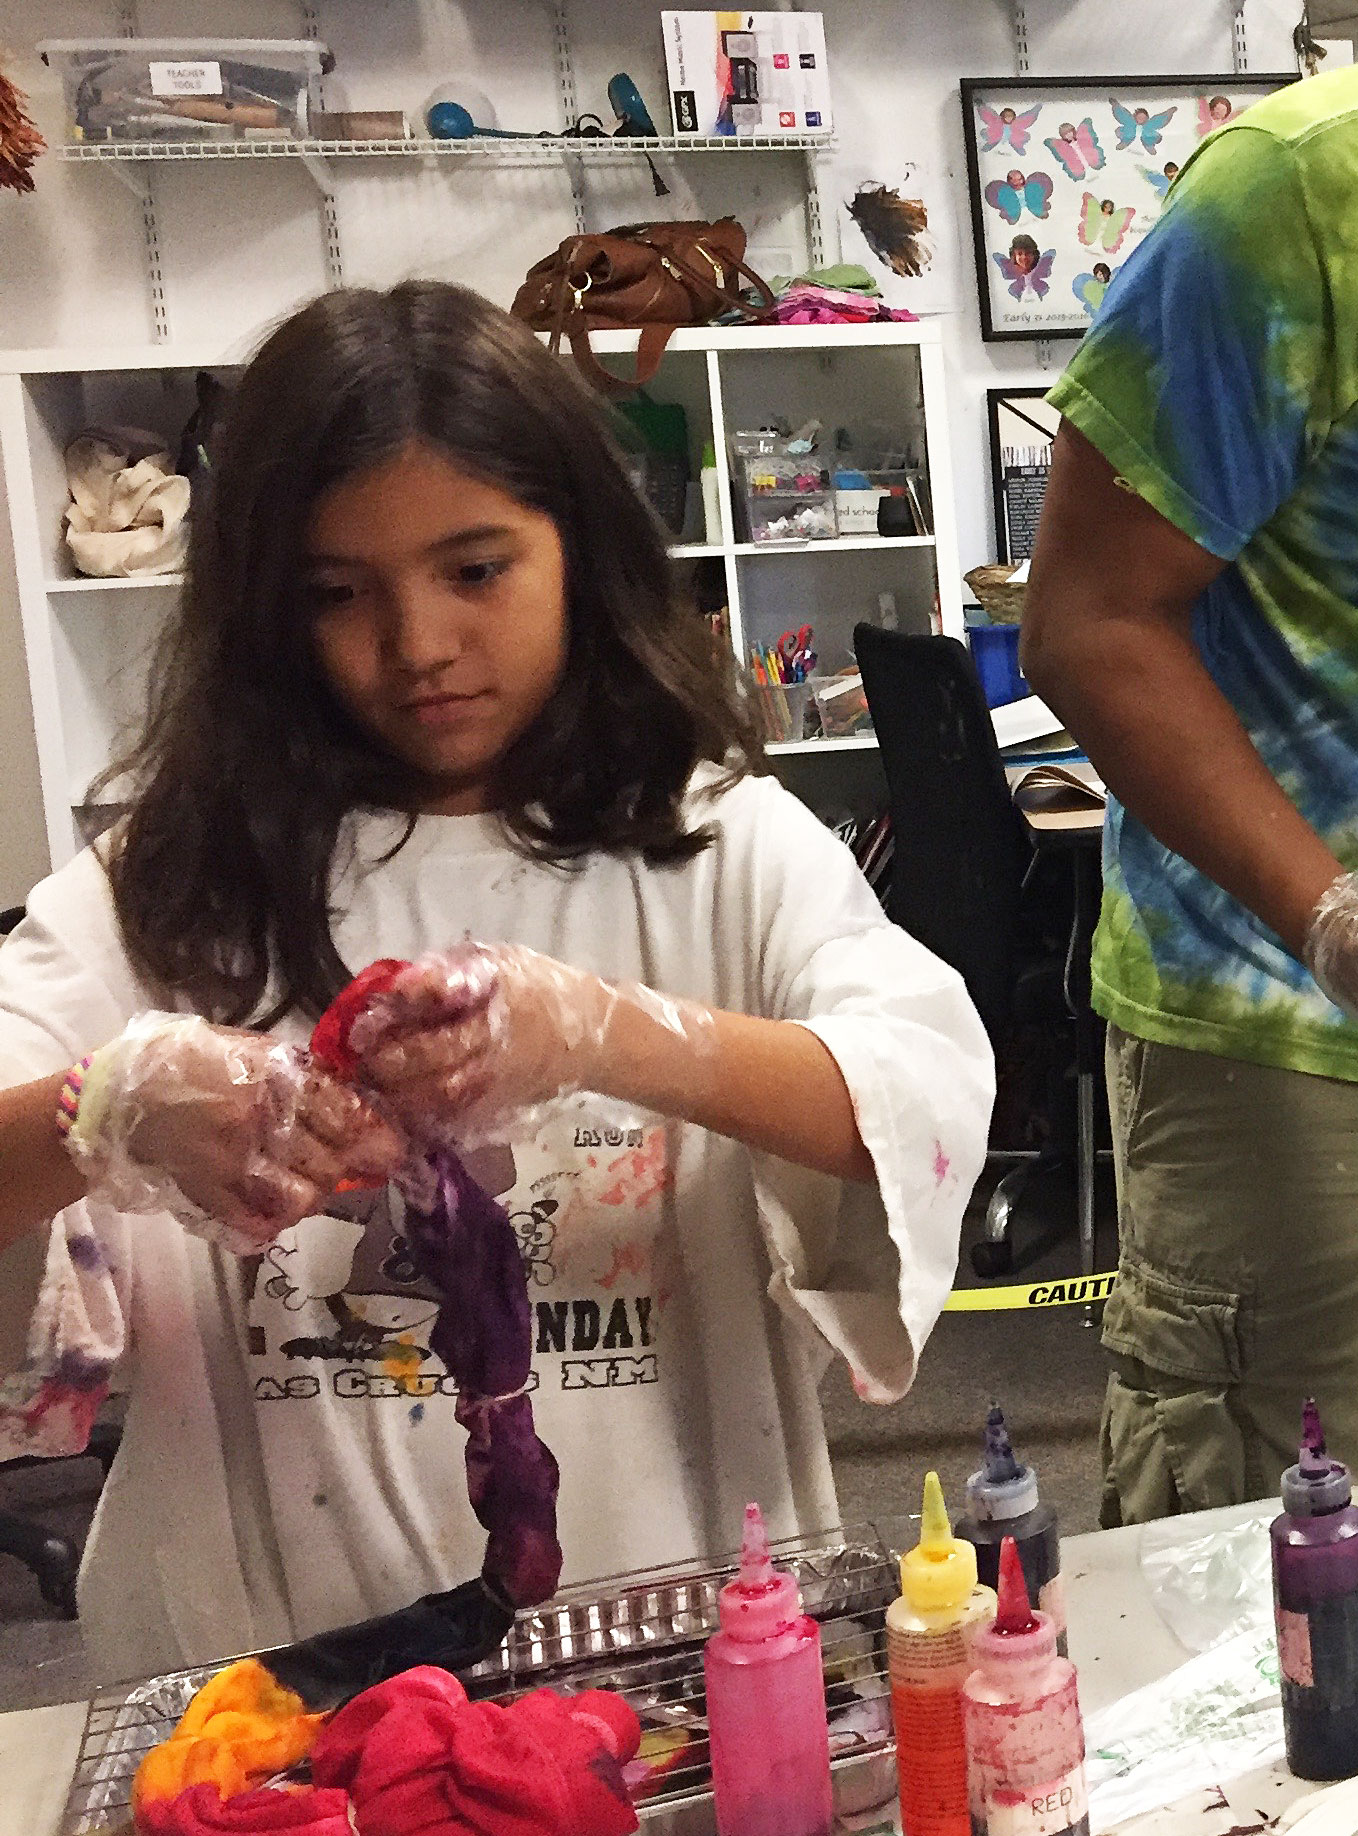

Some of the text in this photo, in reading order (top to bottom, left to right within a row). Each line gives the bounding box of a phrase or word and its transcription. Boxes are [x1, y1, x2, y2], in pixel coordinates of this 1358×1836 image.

[166, 69, 206, 78] TEACHER
[173, 81, 202, 89] TOOLS
[1003, 312, 1031, 324] Early
[1028, 1276, 1116, 1305] CAUTI
[535, 1297, 654, 1354] NDAY
[254, 1375, 321, 1401] AS
[561, 1353, 659, 1391] NM
[1031, 1785, 1074, 1817] RED
